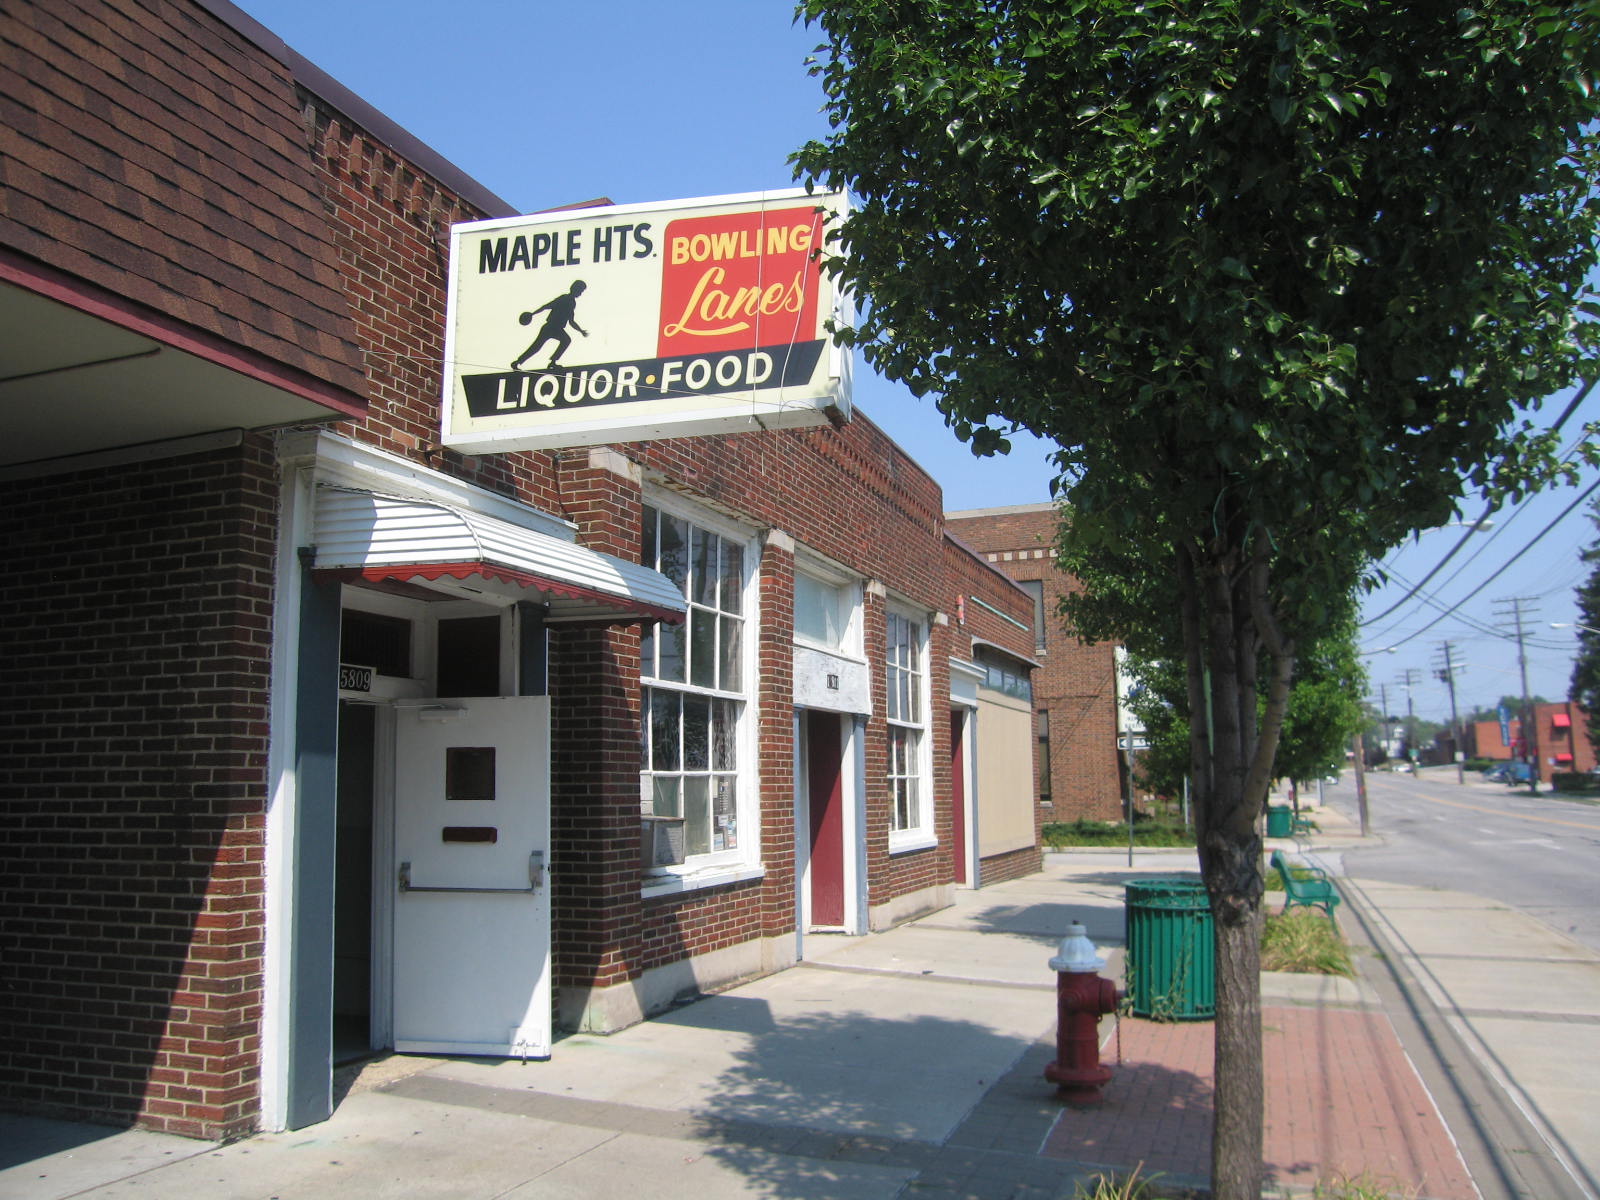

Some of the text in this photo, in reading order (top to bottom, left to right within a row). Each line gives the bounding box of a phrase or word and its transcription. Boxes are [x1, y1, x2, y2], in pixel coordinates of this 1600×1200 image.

[479, 223, 658, 274] MAPLE HTS.
[671, 224, 812, 266] BOWLING
[664, 266, 805, 337] Lanes
[496, 352, 773, 410] LIQUOR FOOD
[340, 669, 371, 690] 5809
